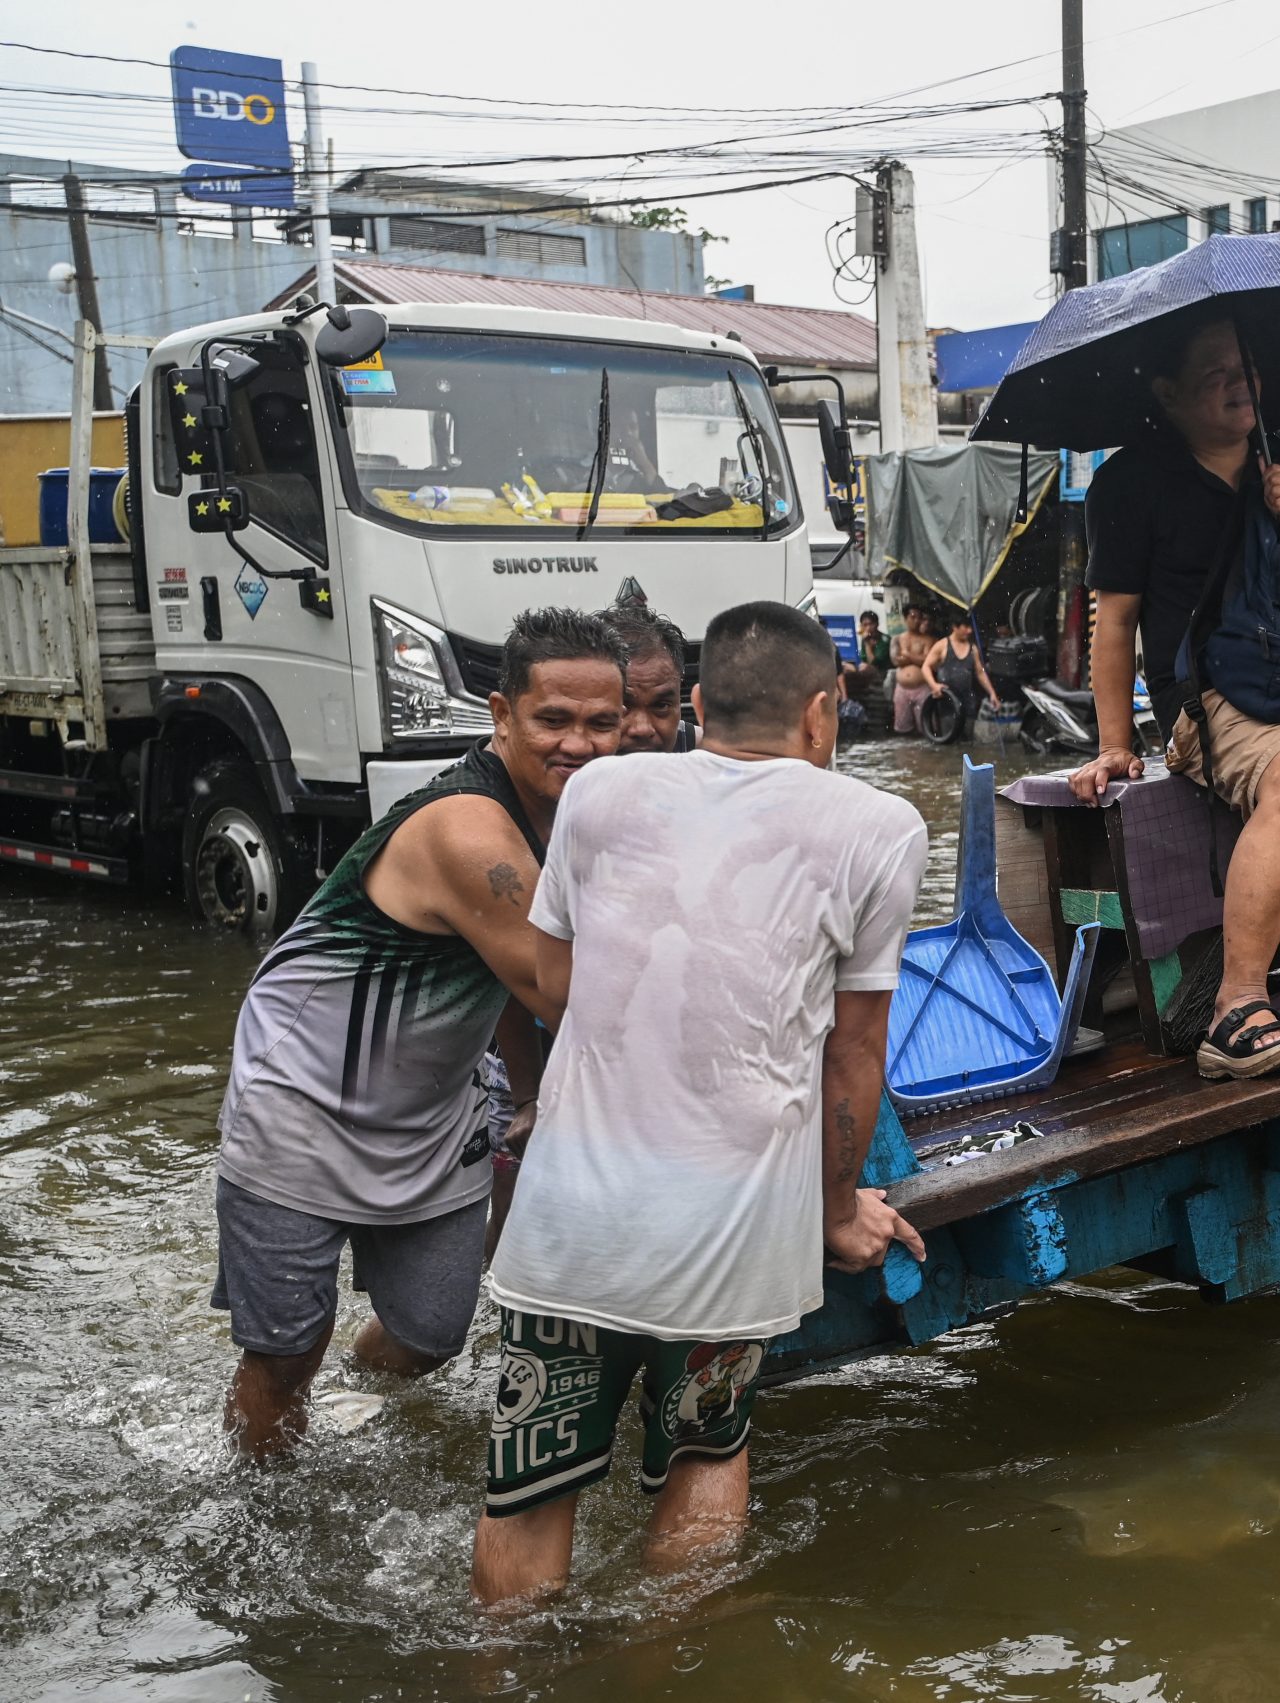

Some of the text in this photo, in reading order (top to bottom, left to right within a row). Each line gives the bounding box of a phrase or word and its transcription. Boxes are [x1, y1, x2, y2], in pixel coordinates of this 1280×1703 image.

[192, 87, 275, 125] BDO
[200, 174, 242, 192] ATM
[493, 556, 599, 574] SINOTRUK
[550, 1371, 600, 1396] 1946
[488, 1412, 580, 1479] TICS
